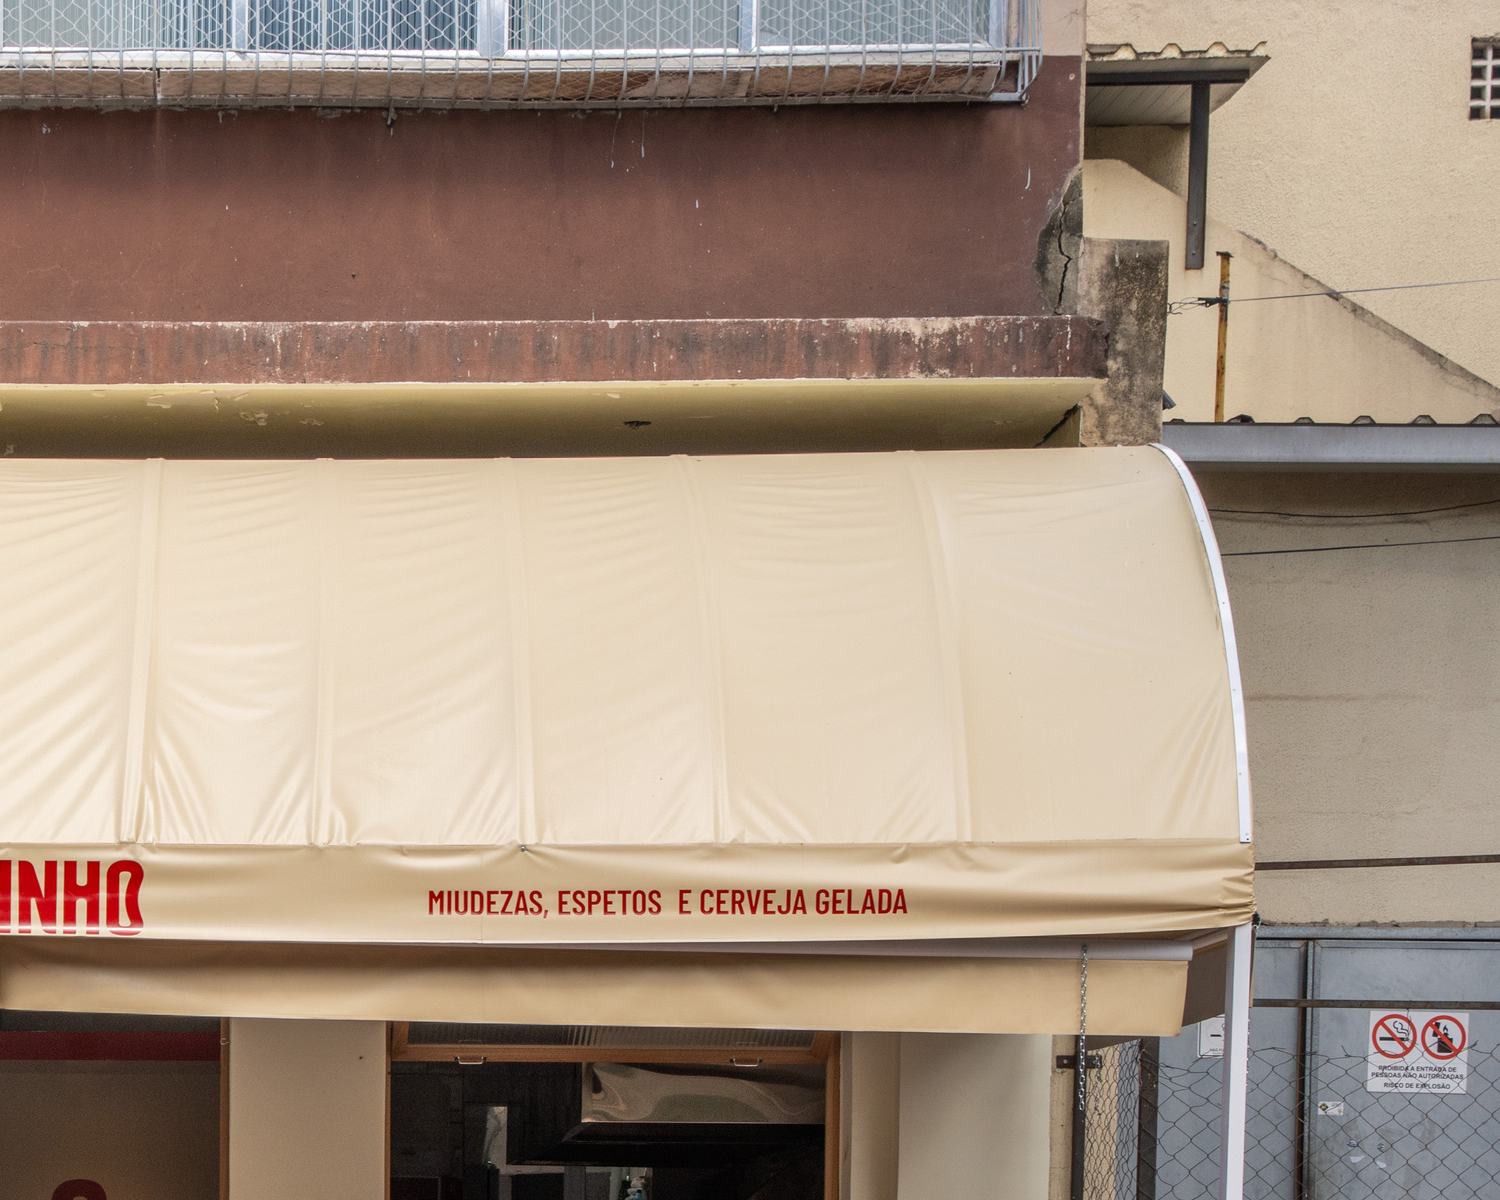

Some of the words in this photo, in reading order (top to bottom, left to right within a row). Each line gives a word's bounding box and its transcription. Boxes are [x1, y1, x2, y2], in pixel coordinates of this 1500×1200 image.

[428, 889, 549, 919] MIUDEZAS,
[557, 889, 662, 916] ESPETOS
[678, 889, 692, 915] E
[700, 889, 808, 915] CERVEJA
[815, 888, 908, 915] GELADA
[1402, 1071, 1417, 1079] NÃO
[1416, 1082, 1451, 1090] EXPLOSÃO
